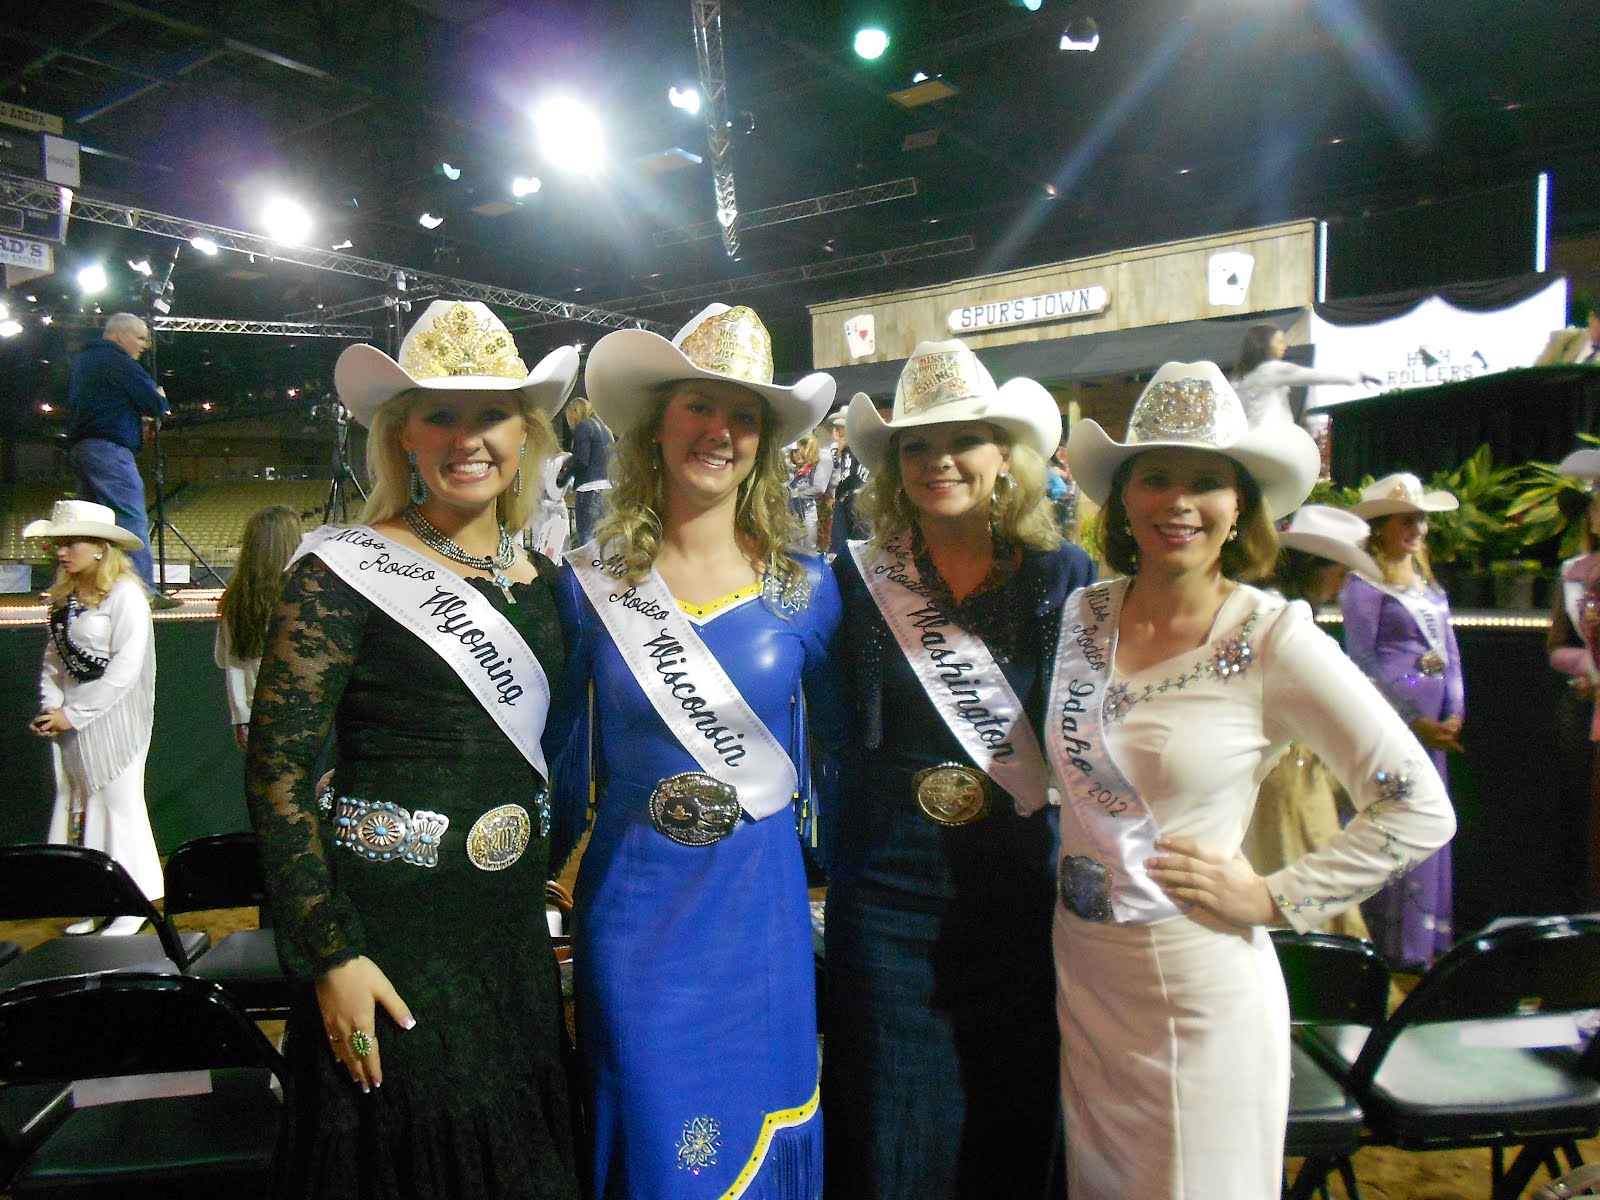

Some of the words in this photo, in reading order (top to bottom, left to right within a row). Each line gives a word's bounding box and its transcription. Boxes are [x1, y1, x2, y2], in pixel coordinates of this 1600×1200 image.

[961, 300, 1025, 327] SPUR'S
[1032, 289, 1090, 317] TOWN
[1386, 364, 1474, 386] ROLLERS
[327, 529, 387, 551] Miss
[359, 552, 436, 582] Rodeo
[419, 585, 524, 706] Wyoming
[1086, 588, 1112, 622] Miss
[1073, 624, 1106, 672] Rodeo
[609, 586, 670, 620] Rodeo
[643, 628, 747, 767] Wisconsin
[906, 600, 1014, 764] Washington
[1061, 678, 1095, 777] Idaho
[1087, 782, 1128, 818] 2012
